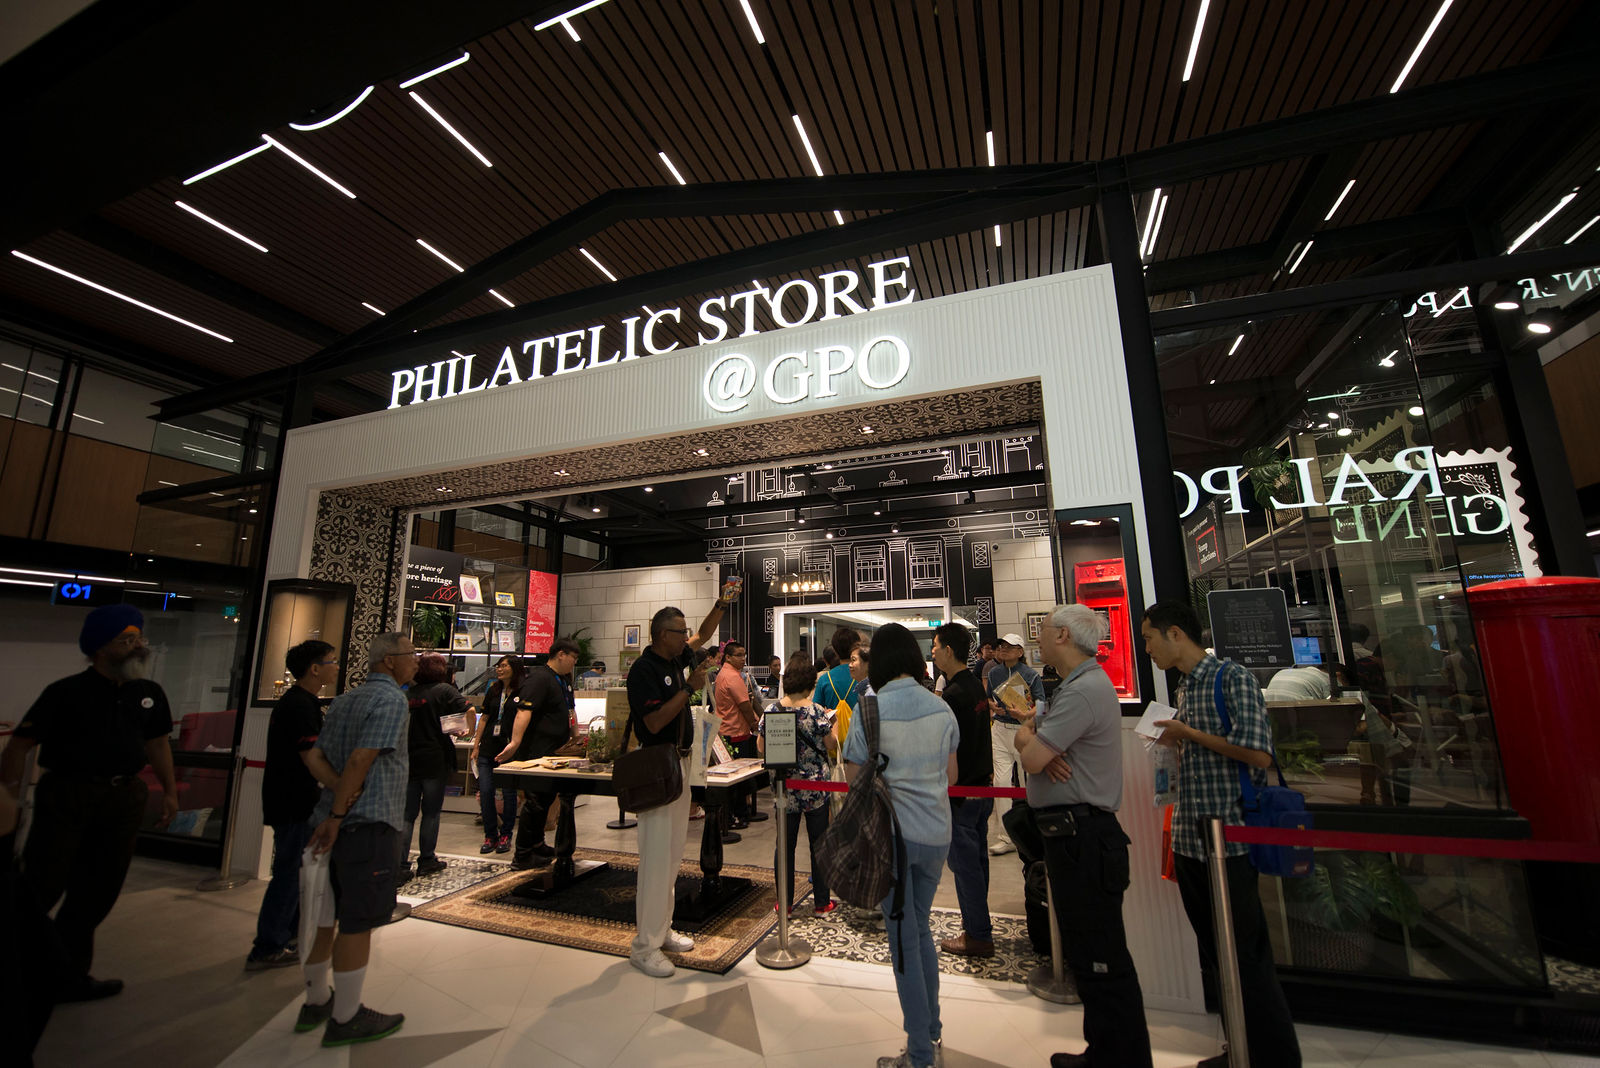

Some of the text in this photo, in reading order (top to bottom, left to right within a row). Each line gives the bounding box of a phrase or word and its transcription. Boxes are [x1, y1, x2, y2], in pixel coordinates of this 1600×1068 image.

[387, 256, 917, 410] PHILATELIC STORE
[702, 334, 912, 414] @GPO
[419, 564, 436, 572] piece
[436, 566, 445, 575] of
[420, 573, 453, 587] heritage
